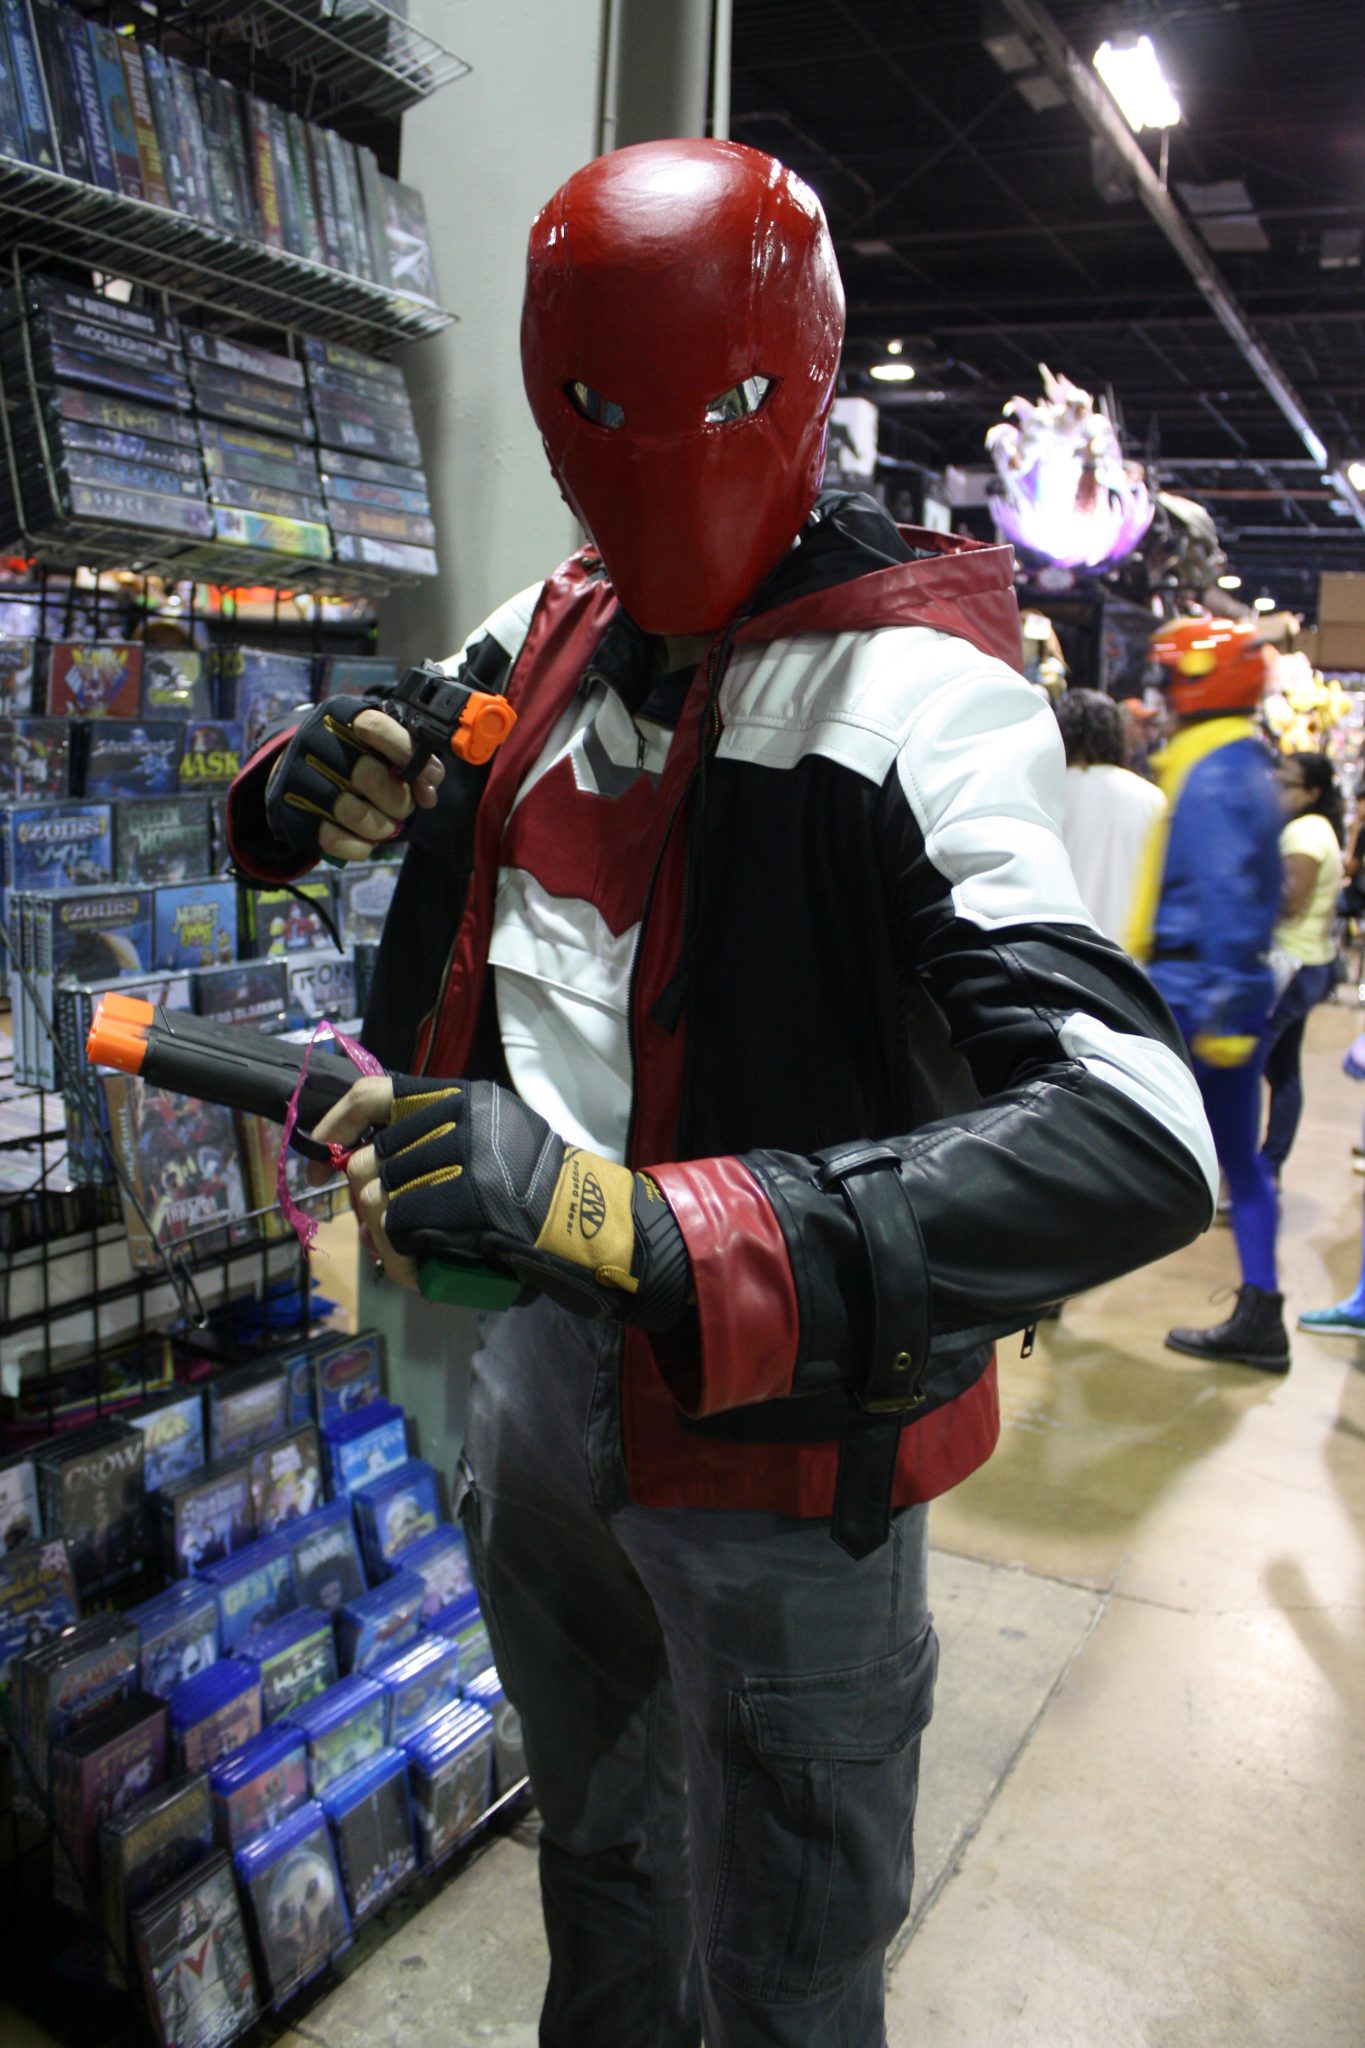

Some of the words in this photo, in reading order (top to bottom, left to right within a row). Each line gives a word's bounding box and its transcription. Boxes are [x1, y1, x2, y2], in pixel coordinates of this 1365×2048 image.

[73, 45, 112, 170] MASKMAN
[74, 323, 168, 362] MOONLIGHTING
[65, 1440, 143, 1491] CROW
[273, 1653, 327, 1695] HULK
